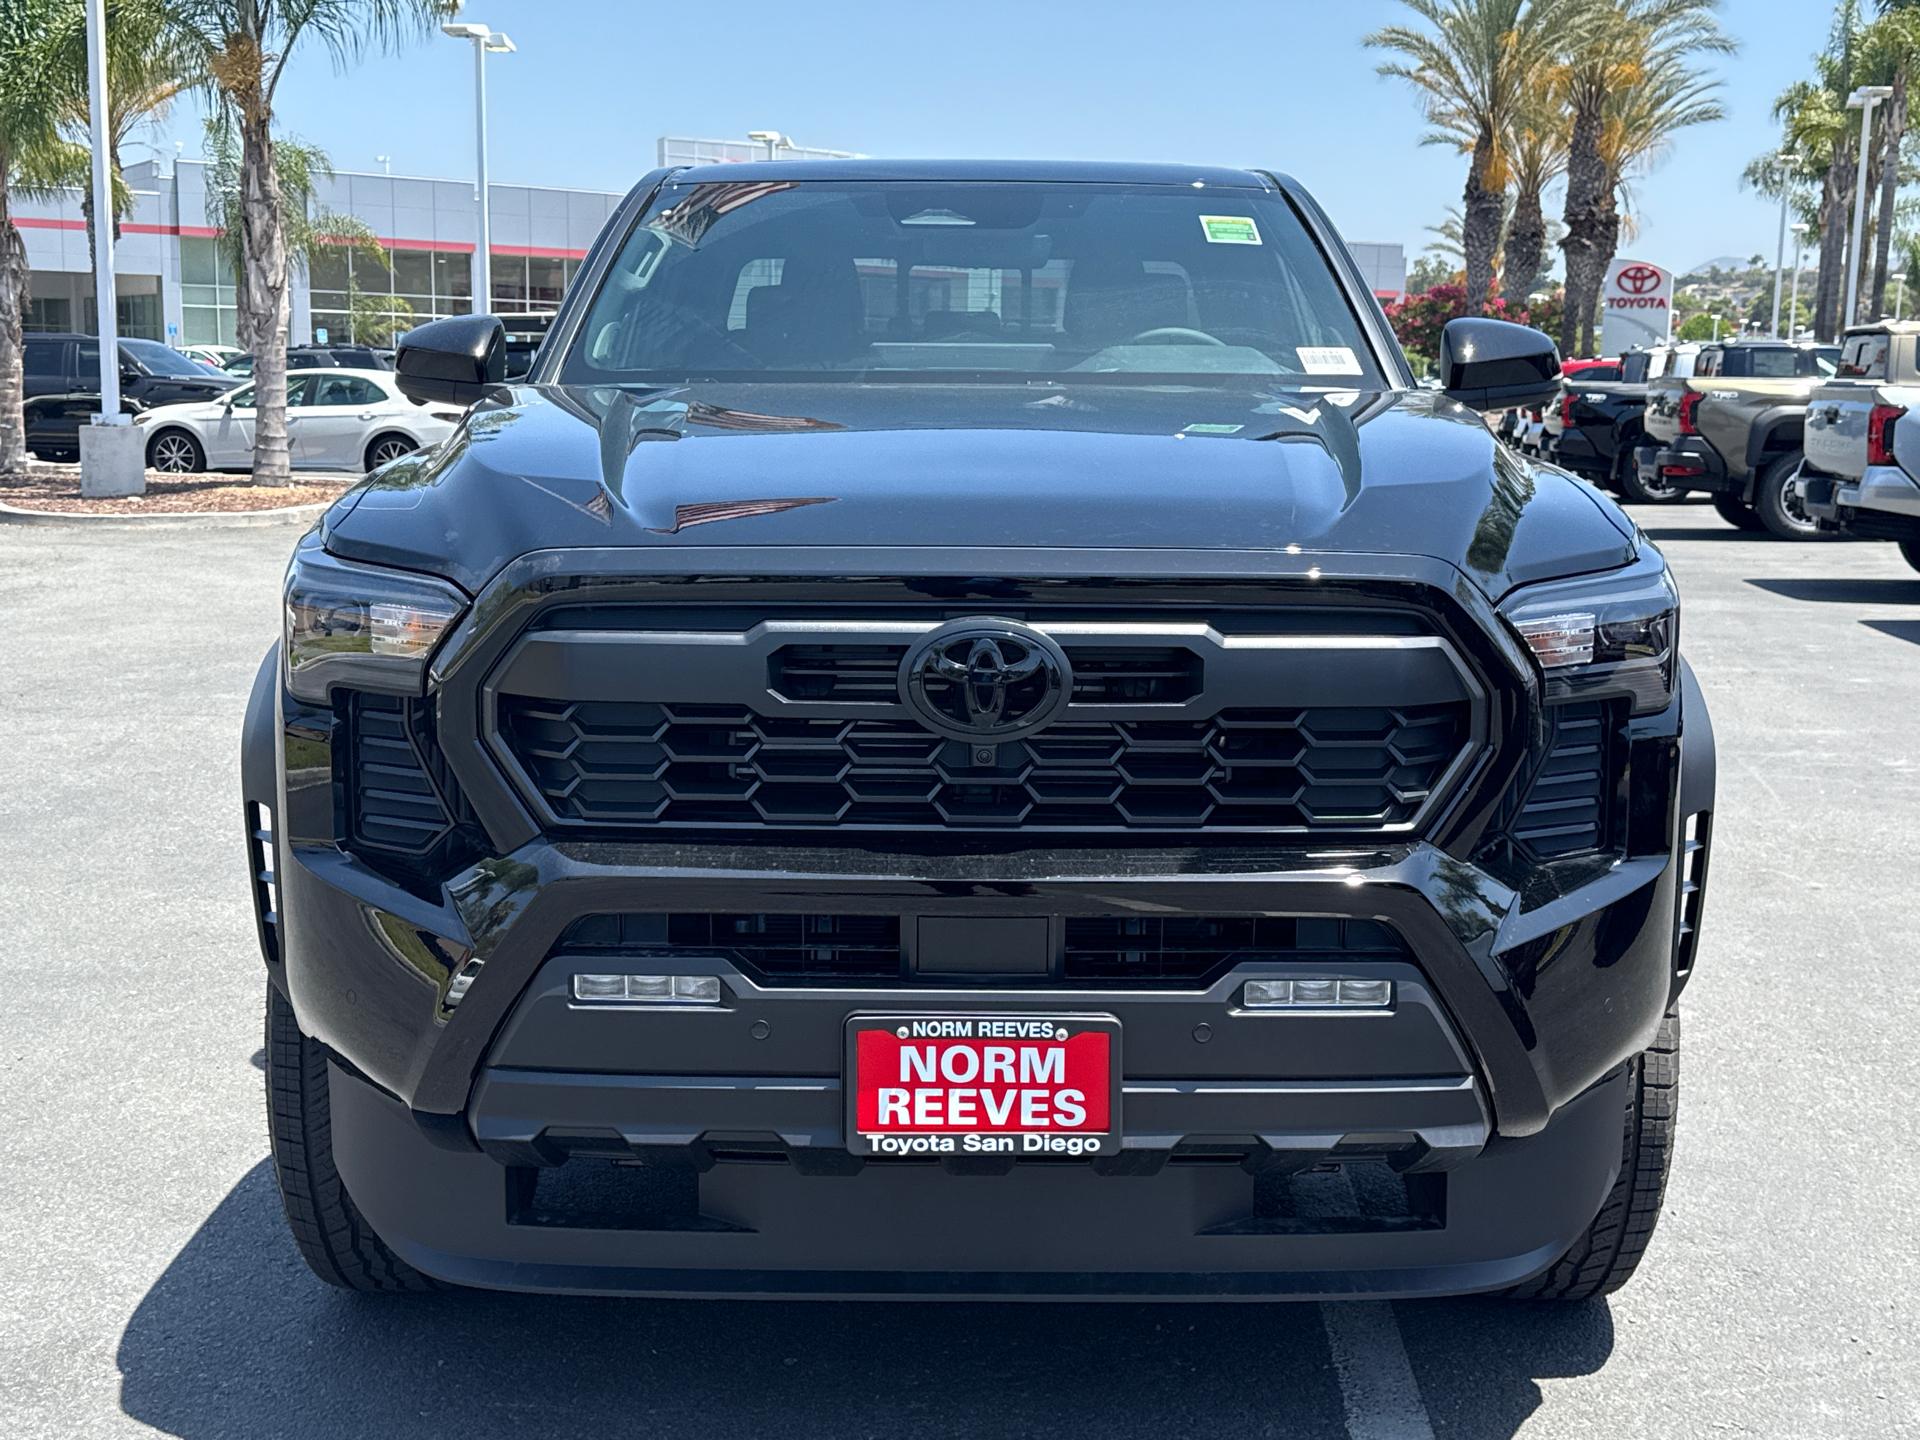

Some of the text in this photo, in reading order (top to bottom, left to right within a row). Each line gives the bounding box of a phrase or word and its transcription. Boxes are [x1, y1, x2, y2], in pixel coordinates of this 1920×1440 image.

[1608, 297, 1667, 309] TOYOTA
[912, 1021, 1054, 1038] NORM REEVES
[900, 1045, 1066, 1084] NORM
[877, 1088, 1087, 1126] REEVES
[866, 1134, 1101, 1155] Toyota San Diego
